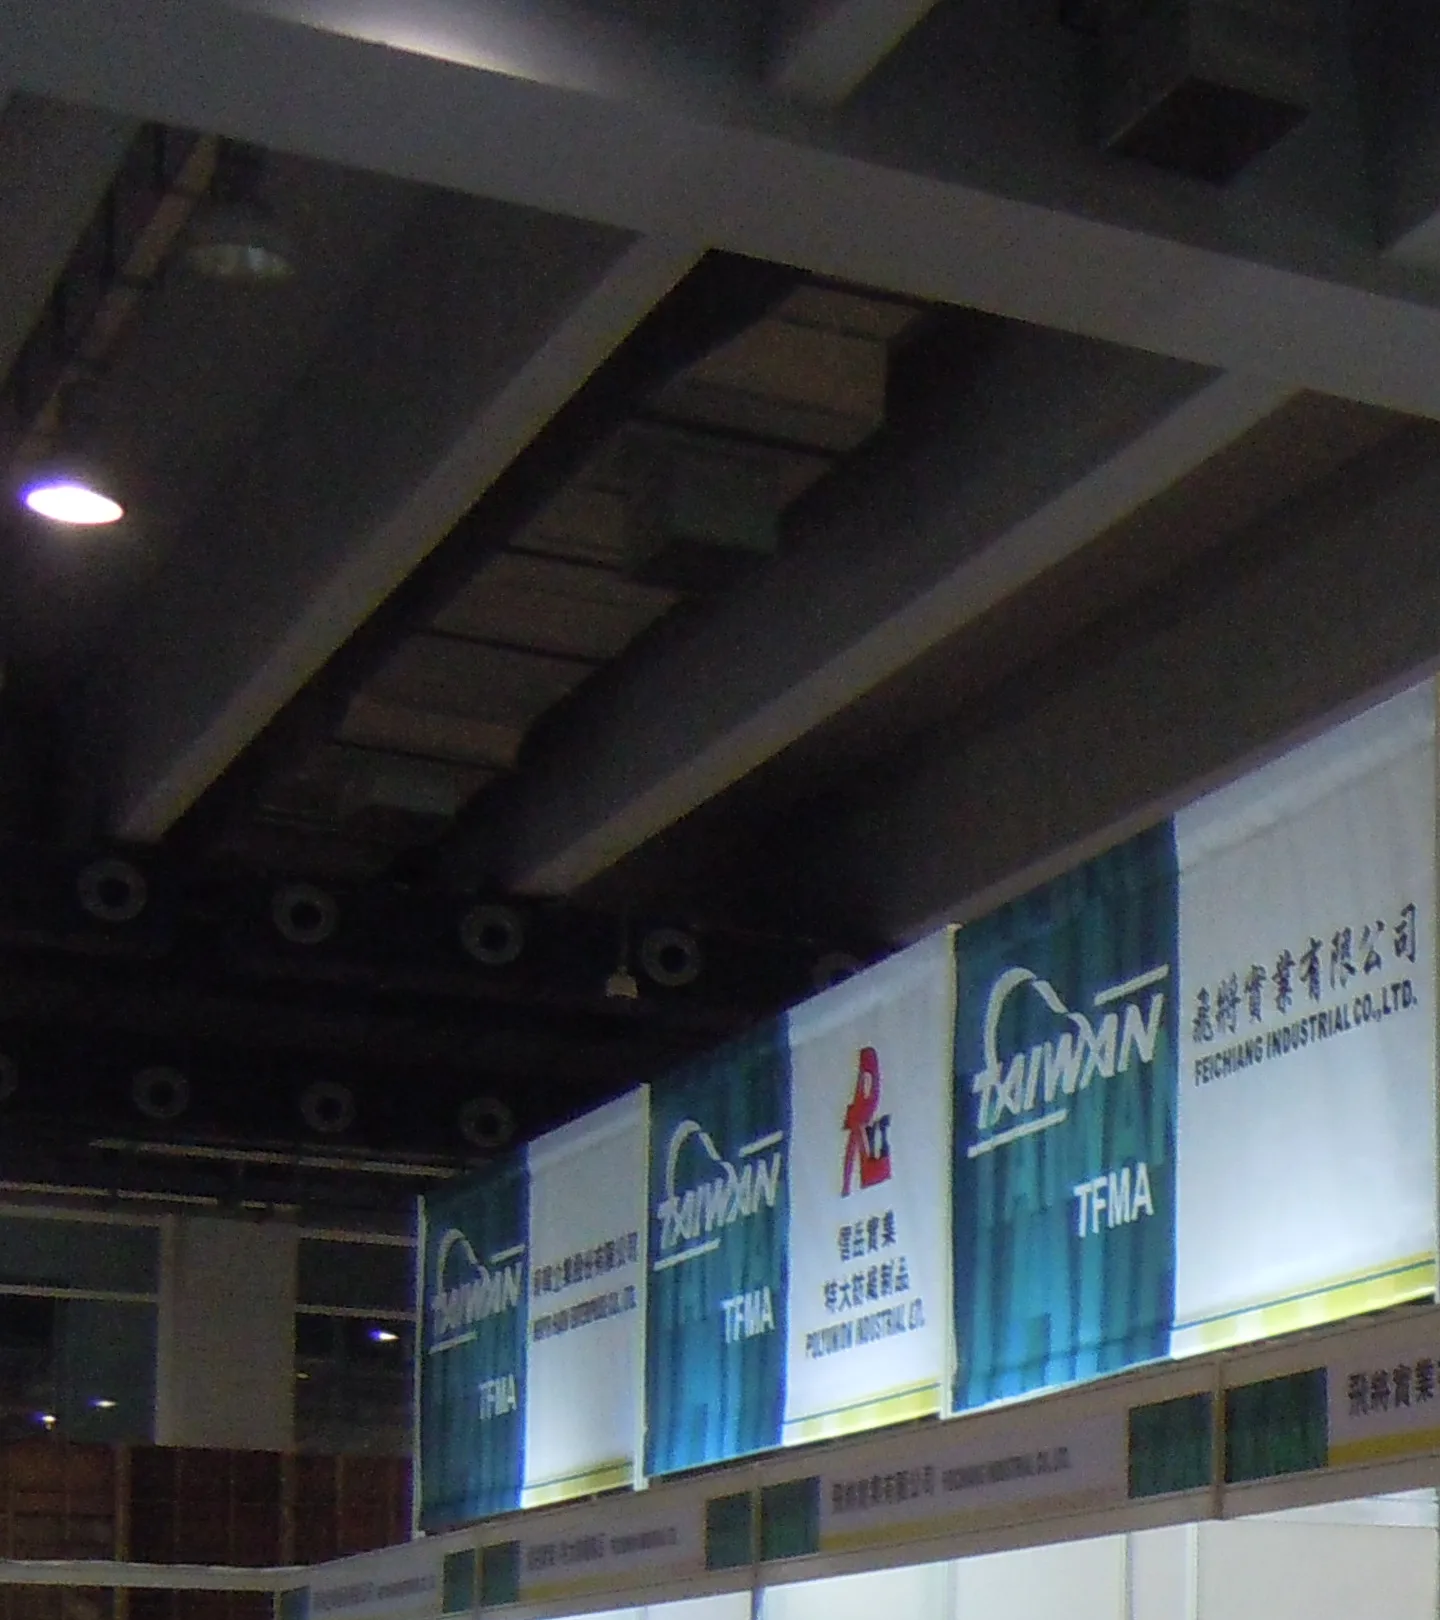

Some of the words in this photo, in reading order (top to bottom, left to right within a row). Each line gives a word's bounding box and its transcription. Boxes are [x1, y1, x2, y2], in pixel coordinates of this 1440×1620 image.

[971, 992, 1164, 1130] TAIWAN
[1265, 1002, 1351, 1060] INDUSTRIAL
[657, 1150, 782, 1250] TAIWAN
[1073, 1161, 1154, 1238] TFMA
[721, 1285, 776, 1344] TFMA
[477, 1373, 518, 1421] TFMA
